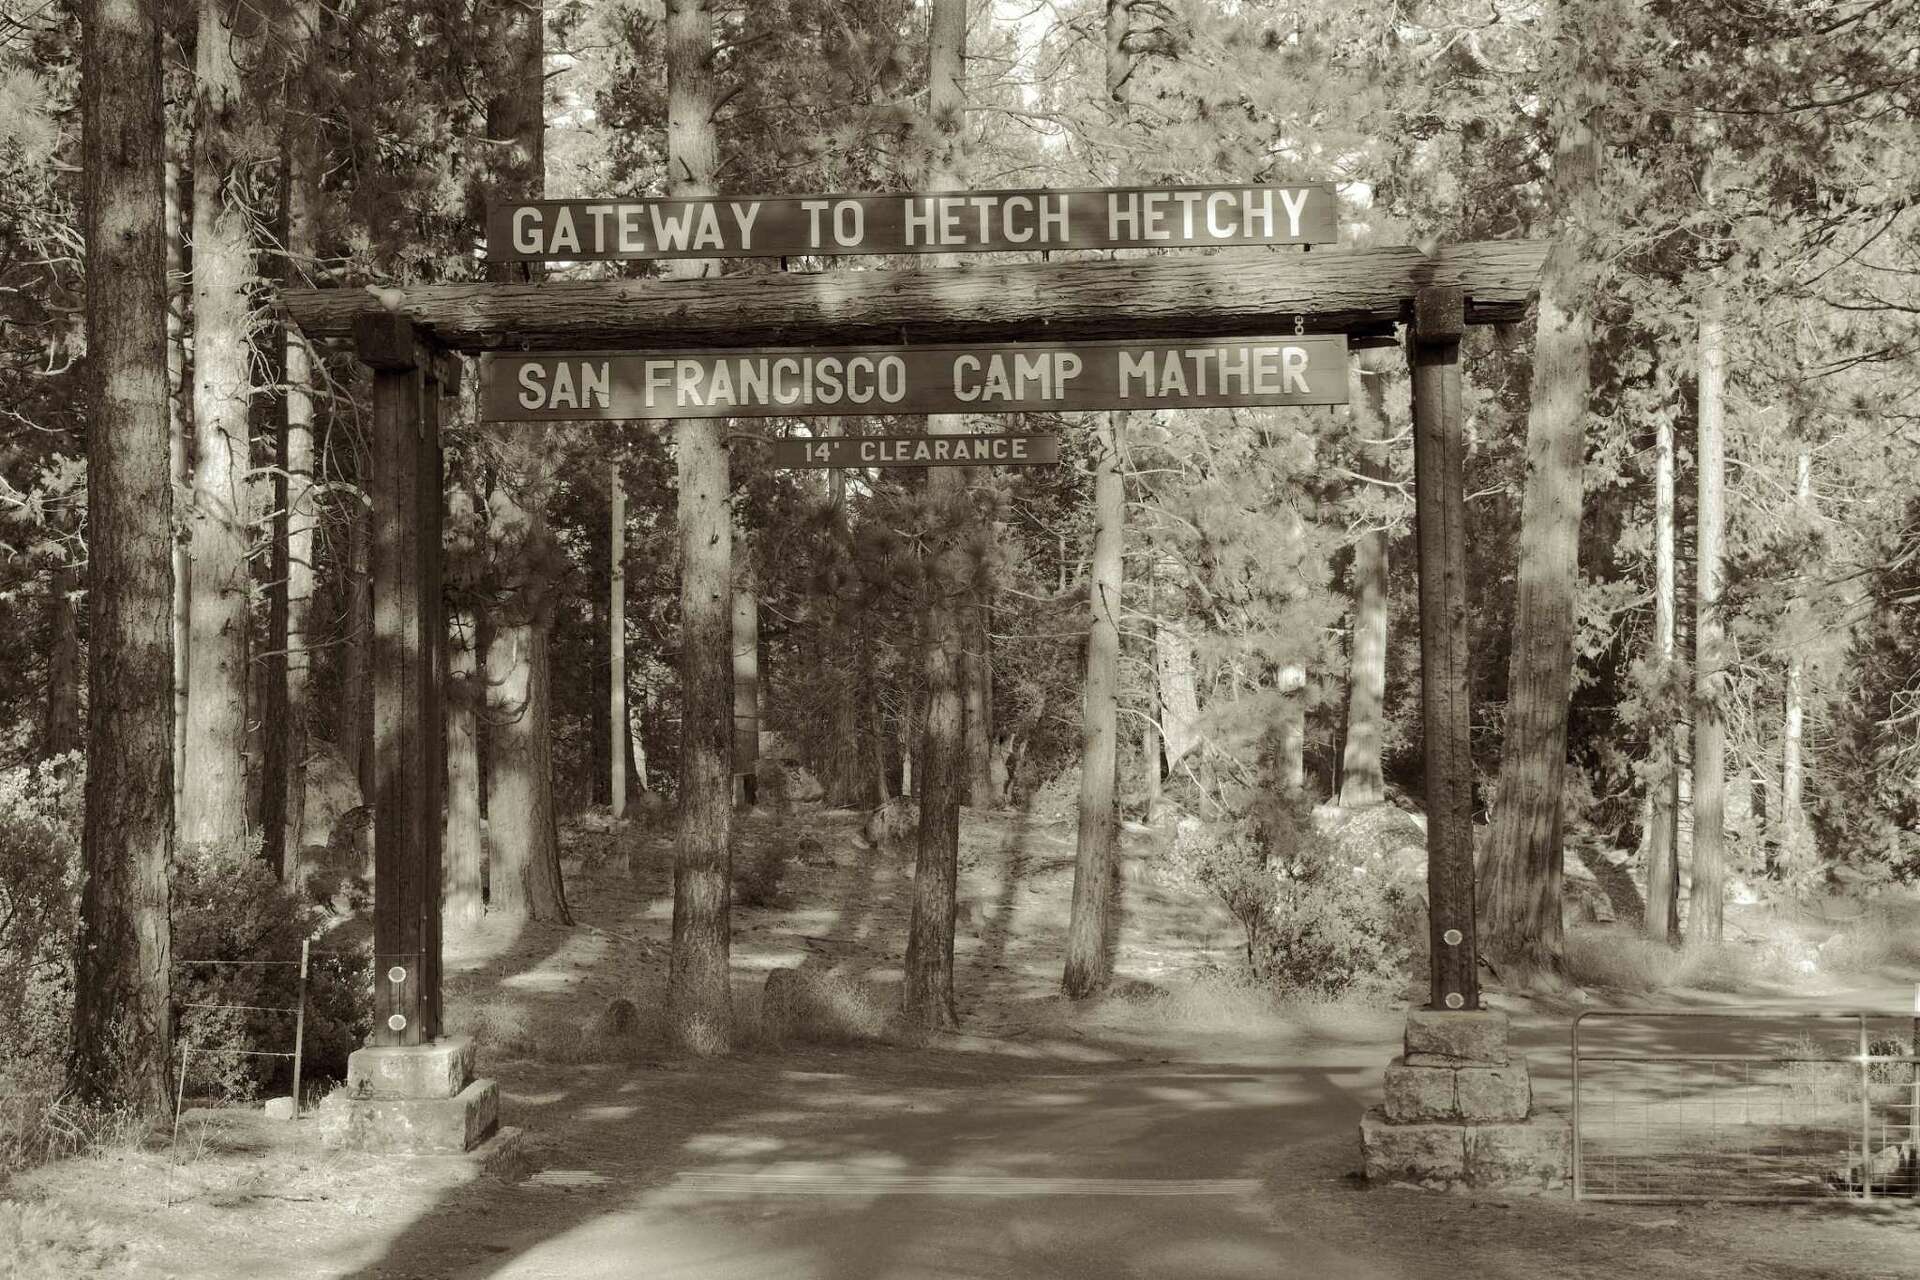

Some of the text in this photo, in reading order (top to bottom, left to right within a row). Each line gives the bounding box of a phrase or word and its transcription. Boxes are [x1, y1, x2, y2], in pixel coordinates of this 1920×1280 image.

[512, 189, 1310, 254] GATEWAY TO HETCH HETCHY
[518, 346, 1311, 410] SAN FRANCISCO CAMP MATHER
[805, 438, 1028, 462] 14' CLEARANCE
